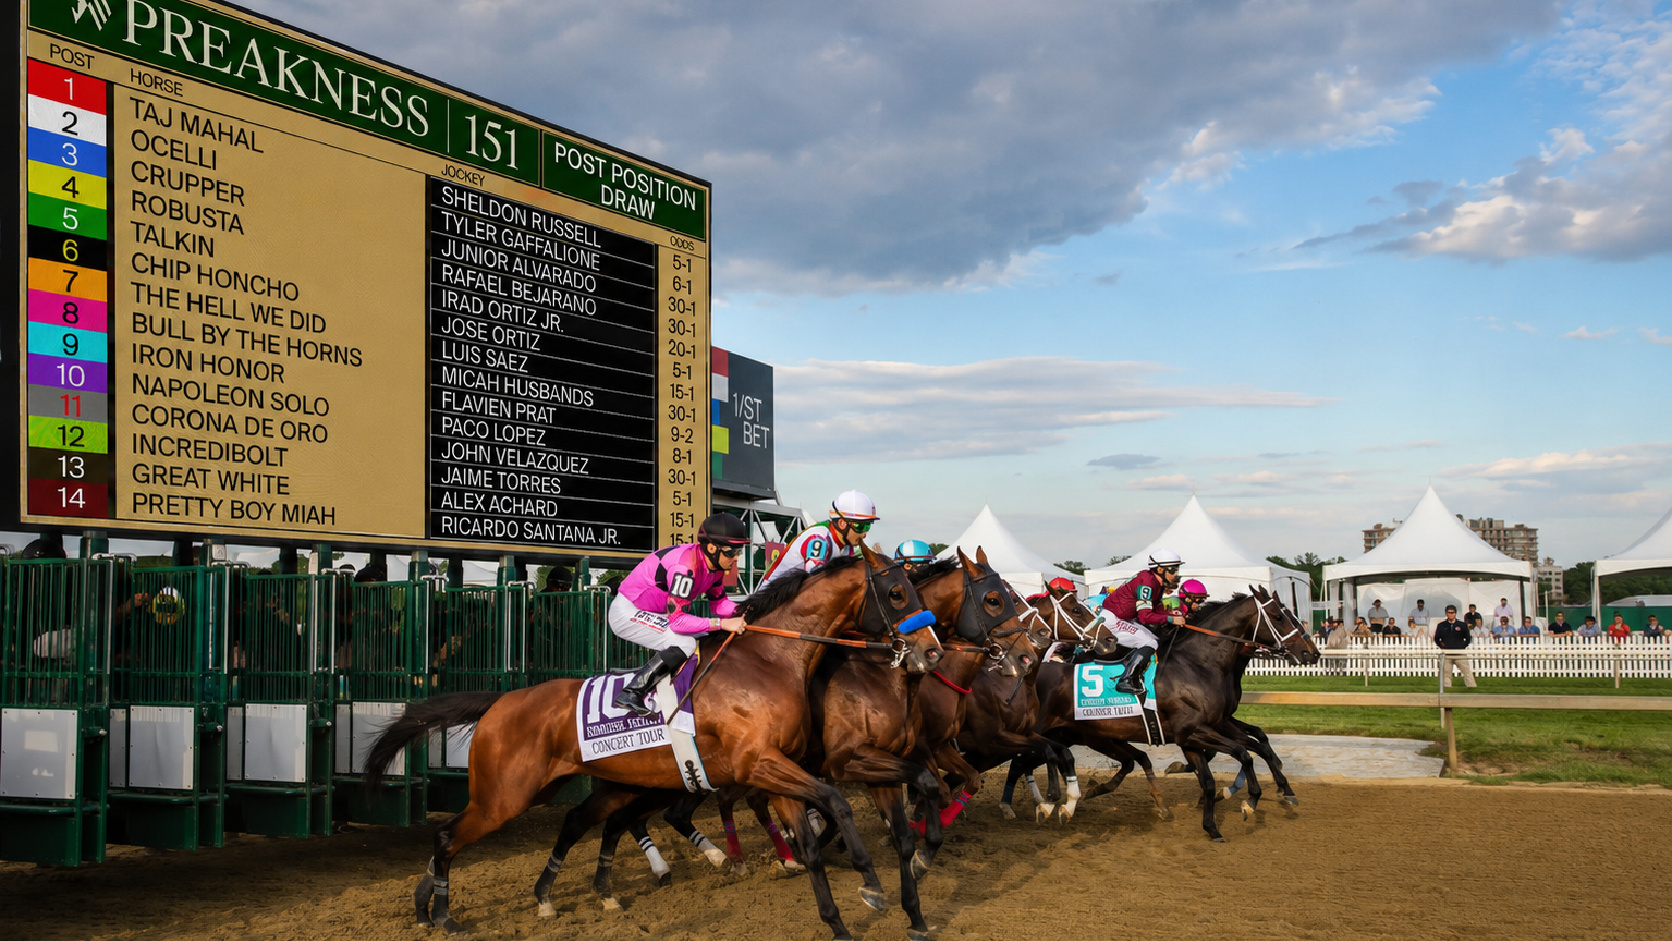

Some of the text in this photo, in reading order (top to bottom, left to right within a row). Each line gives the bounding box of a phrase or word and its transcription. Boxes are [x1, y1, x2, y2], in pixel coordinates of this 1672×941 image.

[50, 43, 95, 69] POST
[122, 0, 429, 137] PREAKNESS
[63, 77, 74, 100] 1
[130, 68, 183, 98] HORSE
[62, 112, 78, 136] 2
[129, 97, 264, 153] TAJ MAHAL
[62, 142, 77, 166] 3
[131, 129, 217, 170] OCELLI
[464, 114, 518, 170] 151
[61, 176, 79, 199] 4
[131, 161, 245, 207] CRUPPER
[441, 163, 486, 187] JOCKEY
[555, 141, 696, 211] POST POSITION
[131, 190, 244, 235] ROBUSTA
[601, 185, 656, 220] DRAW
[62, 208, 78, 230] 5
[442, 186, 601, 248] SHELDON RUSSELL
[62, 240, 78, 261] 6
[130, 221, 214, 258] TALKIN
[441, 211, 600, 271] TYLER GAFFALIONE
[131, 252, 299, 301] CHIP HONCHO
[441, 239, 596, 293] JUNIOR ALVARADO
[673, 255, 691, 273] 5-1
[62, 270, 78, 293] 7
[442, 264, 597, 315] RAFAEL BEJARANO
[673, 276, 692, 295] 6-1
[62, 301, 79, 324] 8
[131, 281, 326, 334] THE HELL WE DID
[442, 289, 563, 332] IRAD ORTIZ JR.
[668, 297, 696, 317] 30-1
[132, 312, 363, 368] BULL BY THE HORNS
[441, 317, 541, 351] JOSE ORTIZ
[668, 318, 696, 338] 30-1
[62, 333, 79, 356] 9
[442, 339, 528, 373] LUIS SAEZ
[668, 339, 696, 359] 20-1
[57, 363, 85, 387] 10
[132, 342, 285, 384] IRON HONOR
[672, 361, 692, 381] 5-1
[132, 373, 329, 417] NAPOLEON SOLO
[442, 366, 594, 407] MICAH HUSBANDS
[670, 383, 694, 402] 15-1
[60, 394, 81, 418] 11
[442, 391, 557, 424] FLAVIEN PRAT
[668, 404, 696, 423] 30-1
[732, 392, 762, 422] 1/ST
[57, 425, 84, 448] 12
[131, 404, 329, 444] CORONA DE ORO
[442, 416, 546, 447] PACO LOPEZ
[671, 427, 694, 444] 9-2
[743, 422, 770, 449] BET
[132, 433, 289, 468] INCREDIBOLT
[441, 441, 589, 475] JOHN VELAZQUEZ
[672, 448, 692, 465] 8-1
[57, 456, 85, 479] 13
[132, 463, 290, 496] GREAT WHITE
[441, 466, 561, 494] JAIME TORRES
[668, 469, 696, 486] 30-1
[57, 487, 86, 509] 14
[132, 492, 336, 526] PRETTY BOY MIAH
[441, 491, 558, 517] ALEX ACHARD
[672, 490, 692, 507] 5-1
[442, 516, 621, 545] RICARDO SANTANA JR.
[670, 512, 694, 528] 15-1
[673, 574, 694, 599] 10
[1082, 665, 1104, 698] 5
